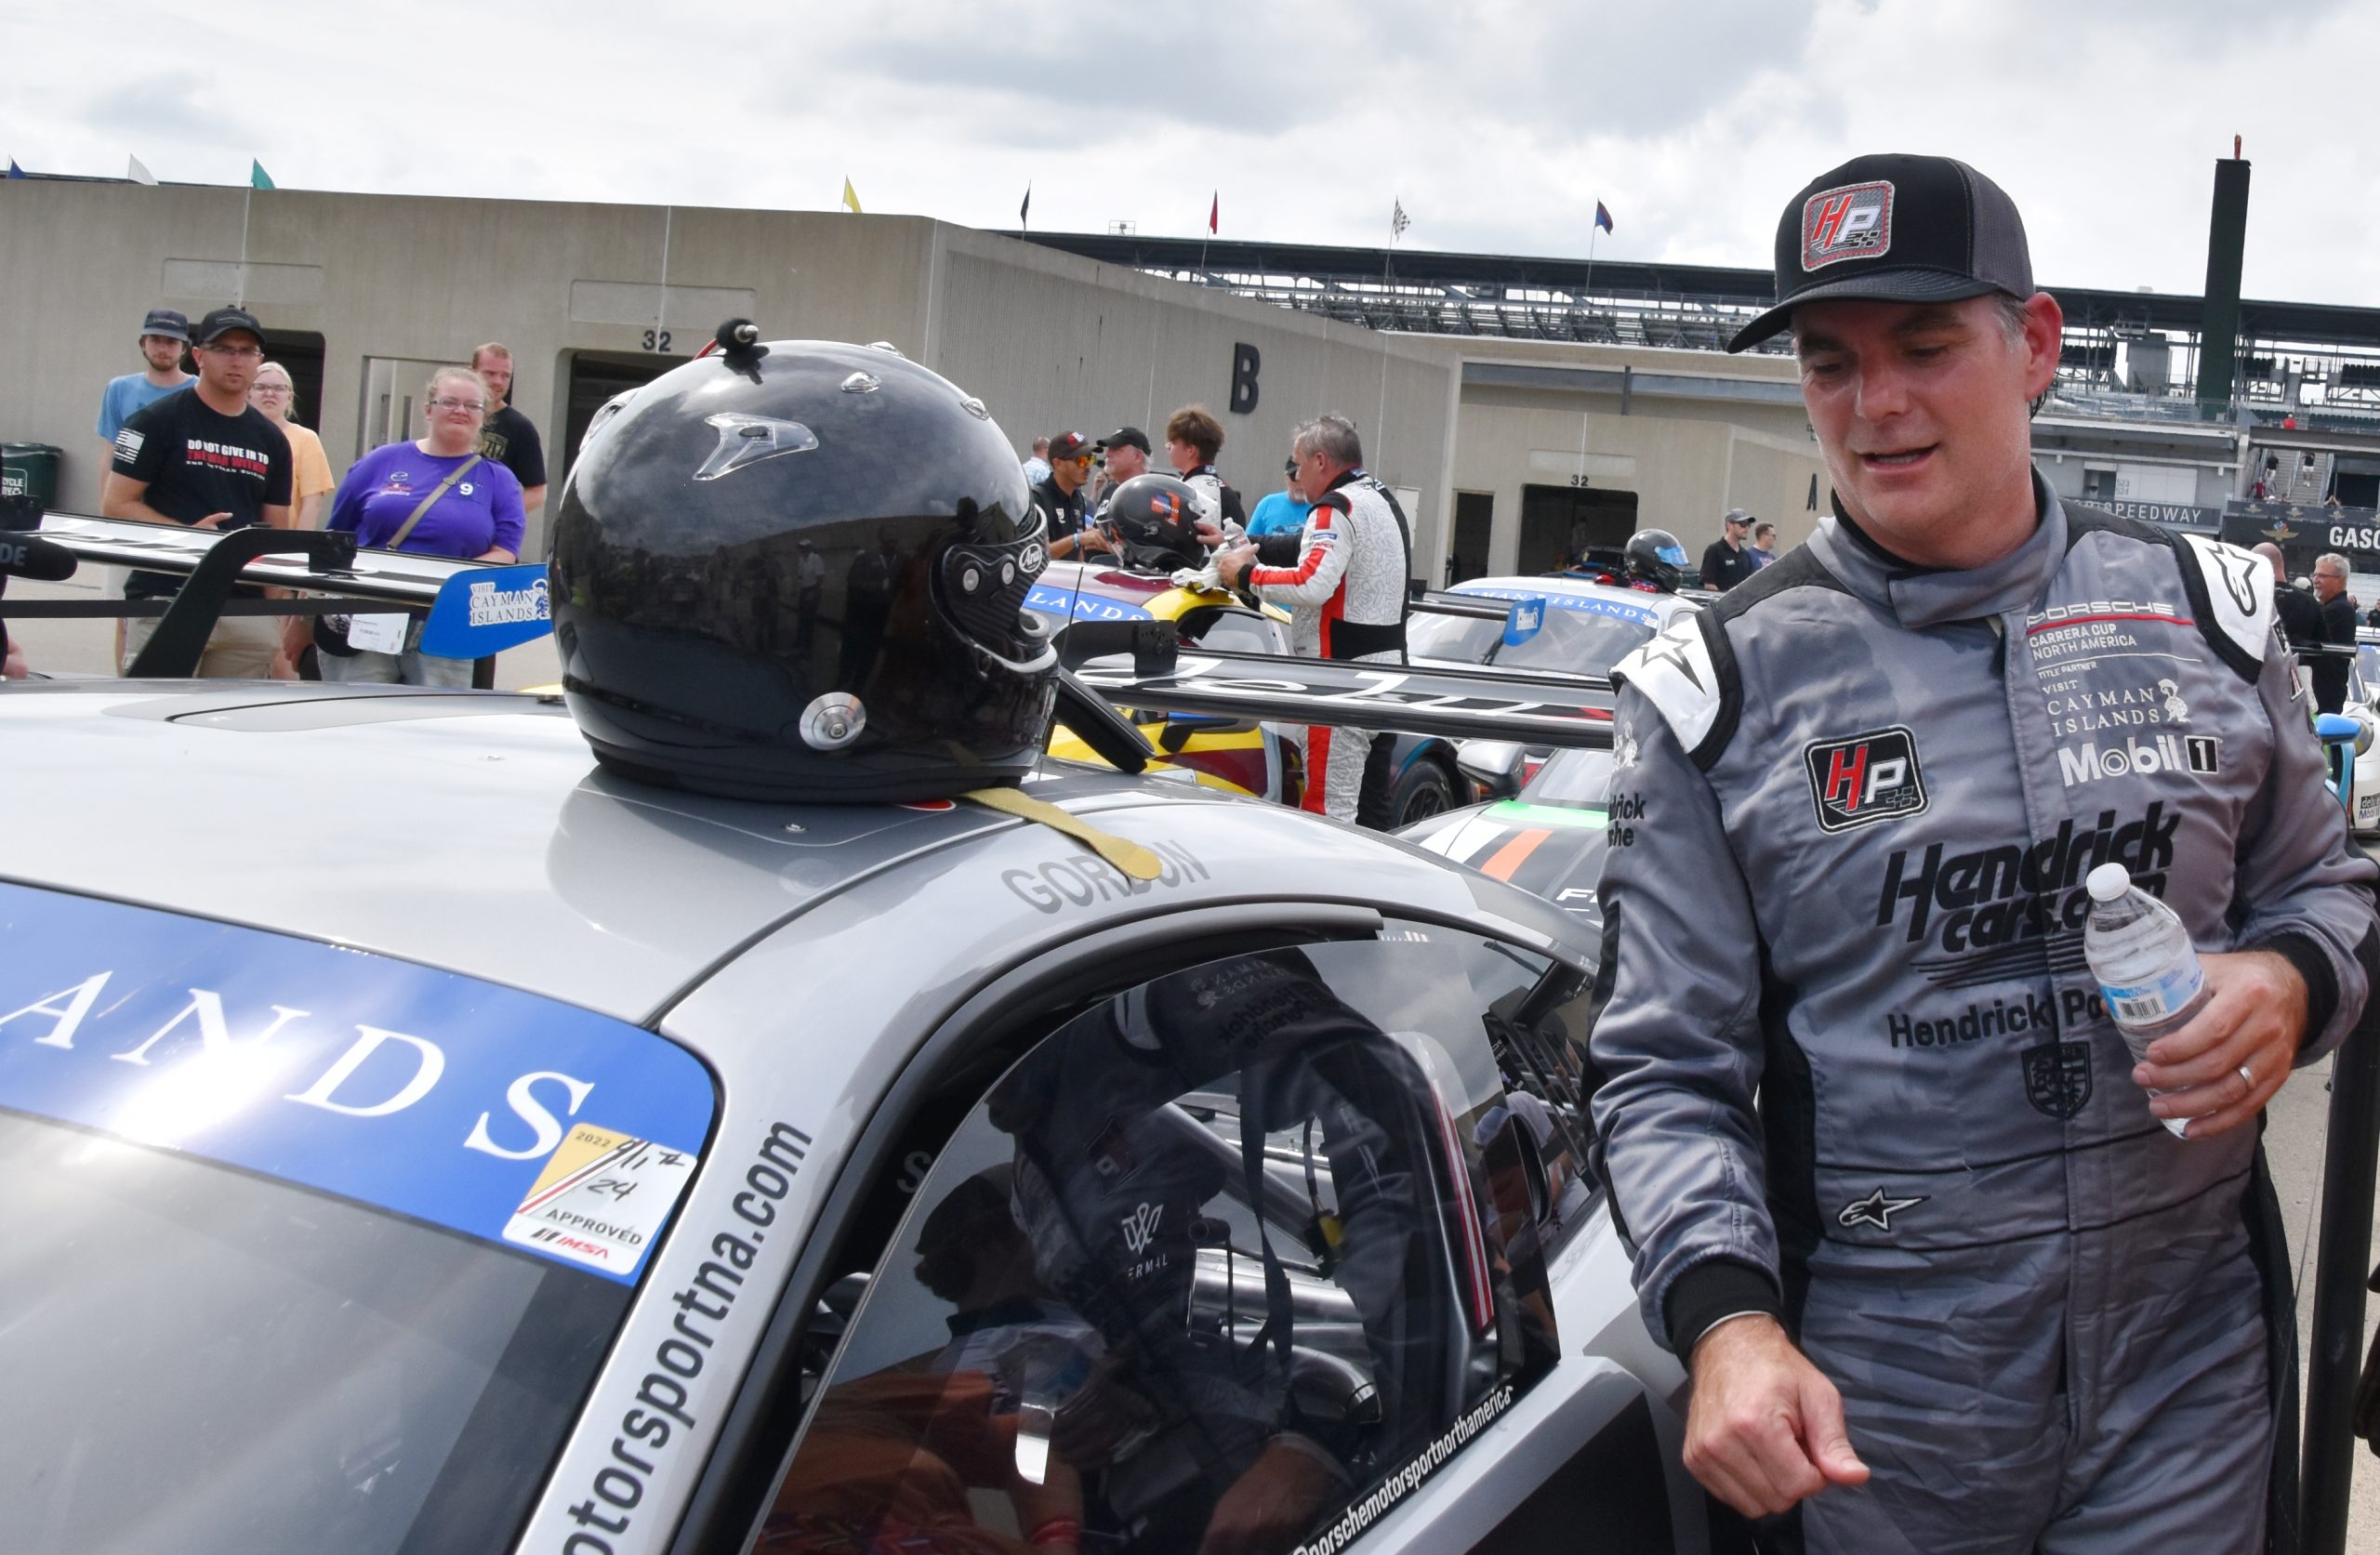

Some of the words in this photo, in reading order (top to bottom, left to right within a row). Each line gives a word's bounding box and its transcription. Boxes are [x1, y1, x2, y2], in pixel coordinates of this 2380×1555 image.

[1812, 193, 1881, 250] HP
[642, 330, 671, 352] 32
[1230, 342, 1261, 415] B
[188, 440, 202, 450] DO
[221, 444, 245, 457] GIVE
[258, 452, 269, 465] TO
[459, 482, 473, 495] 9
[1571, 474, 1588, 487] 32
[1806, 472, 1818, 511] A
[2104, 501, 2202, 523] SPEEDWAY
[471, 592, 533, 609] CAYMAN
[472, 585, 494, 593] VISIT
[471, 608, 533, 625] ISLANDS
[2026, 601, 2175, 627] PORSCHE
[2029, 626, 2089, 648] CARRERA
[2092, 624, 2117, 636] CUP
[2033, 643, 2078, 661] NORTH
[2081, 635, 2137, 651] AMERICA
[2038, 668, 2060, 679] TITLE
[2061, 662, 2097, 674] PARTNER
[2043, 679, 2079, 695] VISIT
[2047, 688, 2155, 716] CAYMAN
[2052, 708, 2162, 737] ISLANDS
[2057, 734, 2184, 787] Mobil
[1824, 743, 1907, 812] HP
[1876, 800, 2181, 943] Hendrick
[1887, 992, 2052, 1048] Hendrick
[575, 1131, 611, 1148] 2022
[588, 1179, 639, 1202] 24
[546, 1208, 642, 1245] APPROVED
[556, 1236, 609, 1259] IMSA
[562, 1121, 813, 1555] otorsportna.com
